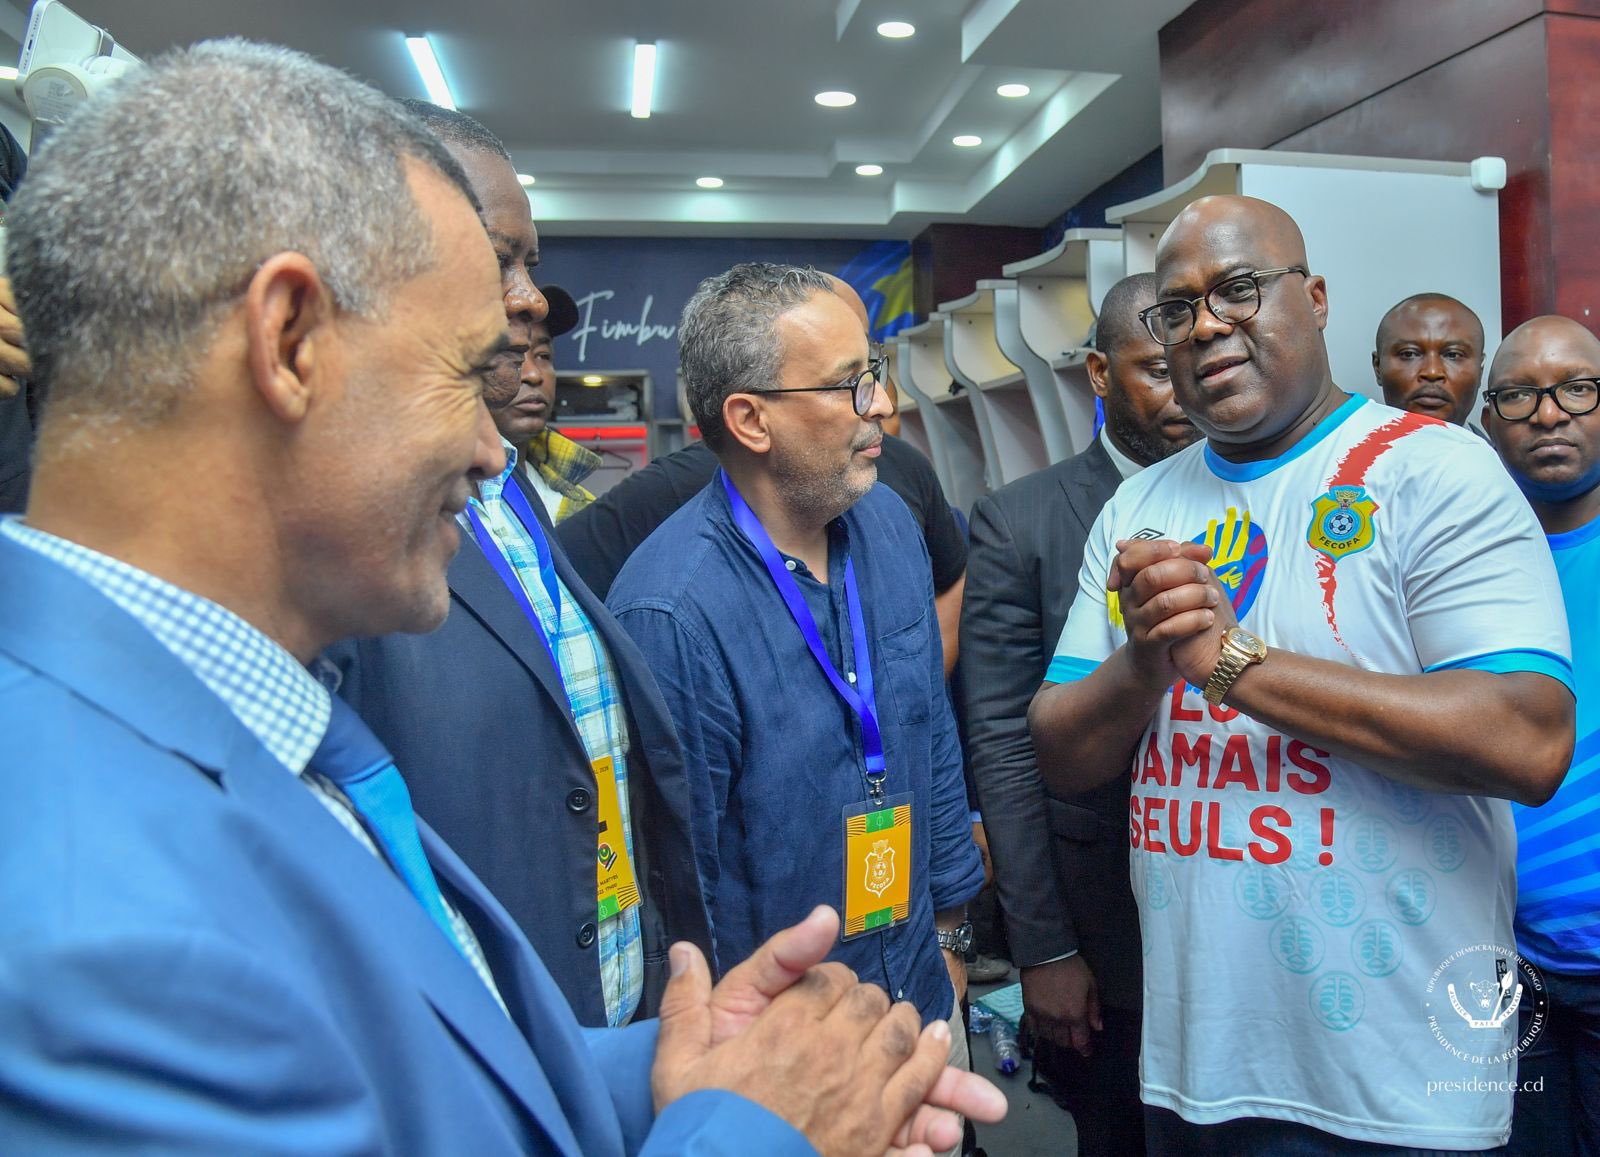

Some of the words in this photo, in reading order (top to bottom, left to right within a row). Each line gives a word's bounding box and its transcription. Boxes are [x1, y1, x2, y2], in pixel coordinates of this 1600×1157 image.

[1319, 535, 1360, 550] FECOFA
[1130, 795, 1293, 865] SEULS
[1318, 807, 1335, 866] !
